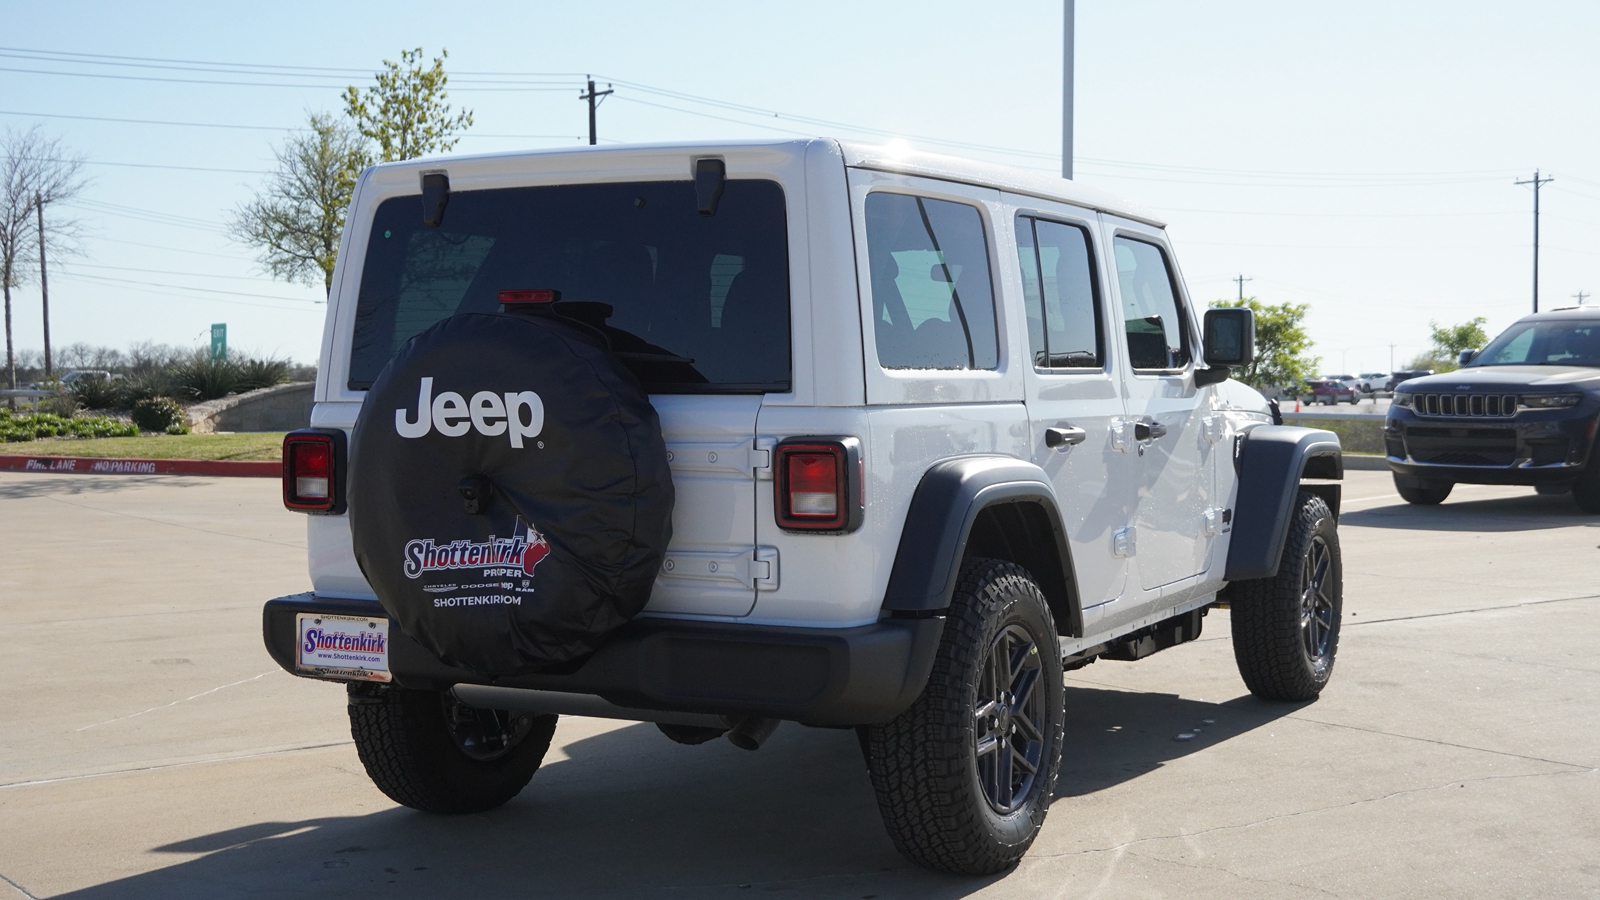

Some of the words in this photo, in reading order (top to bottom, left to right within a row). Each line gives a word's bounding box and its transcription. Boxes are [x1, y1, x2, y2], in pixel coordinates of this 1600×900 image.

[213, 329, 224, 338] EXIT
[395, 376, 545, 449] Jeep
[50, 459, 77, 471] LANE
[94, 460, 110, 472] NO
[111, 461, 156, 473] PARKING
[304, 628, 387, 654] Shottenkirk
[318, 652, 381, 663] www.Shottenkirk.com
